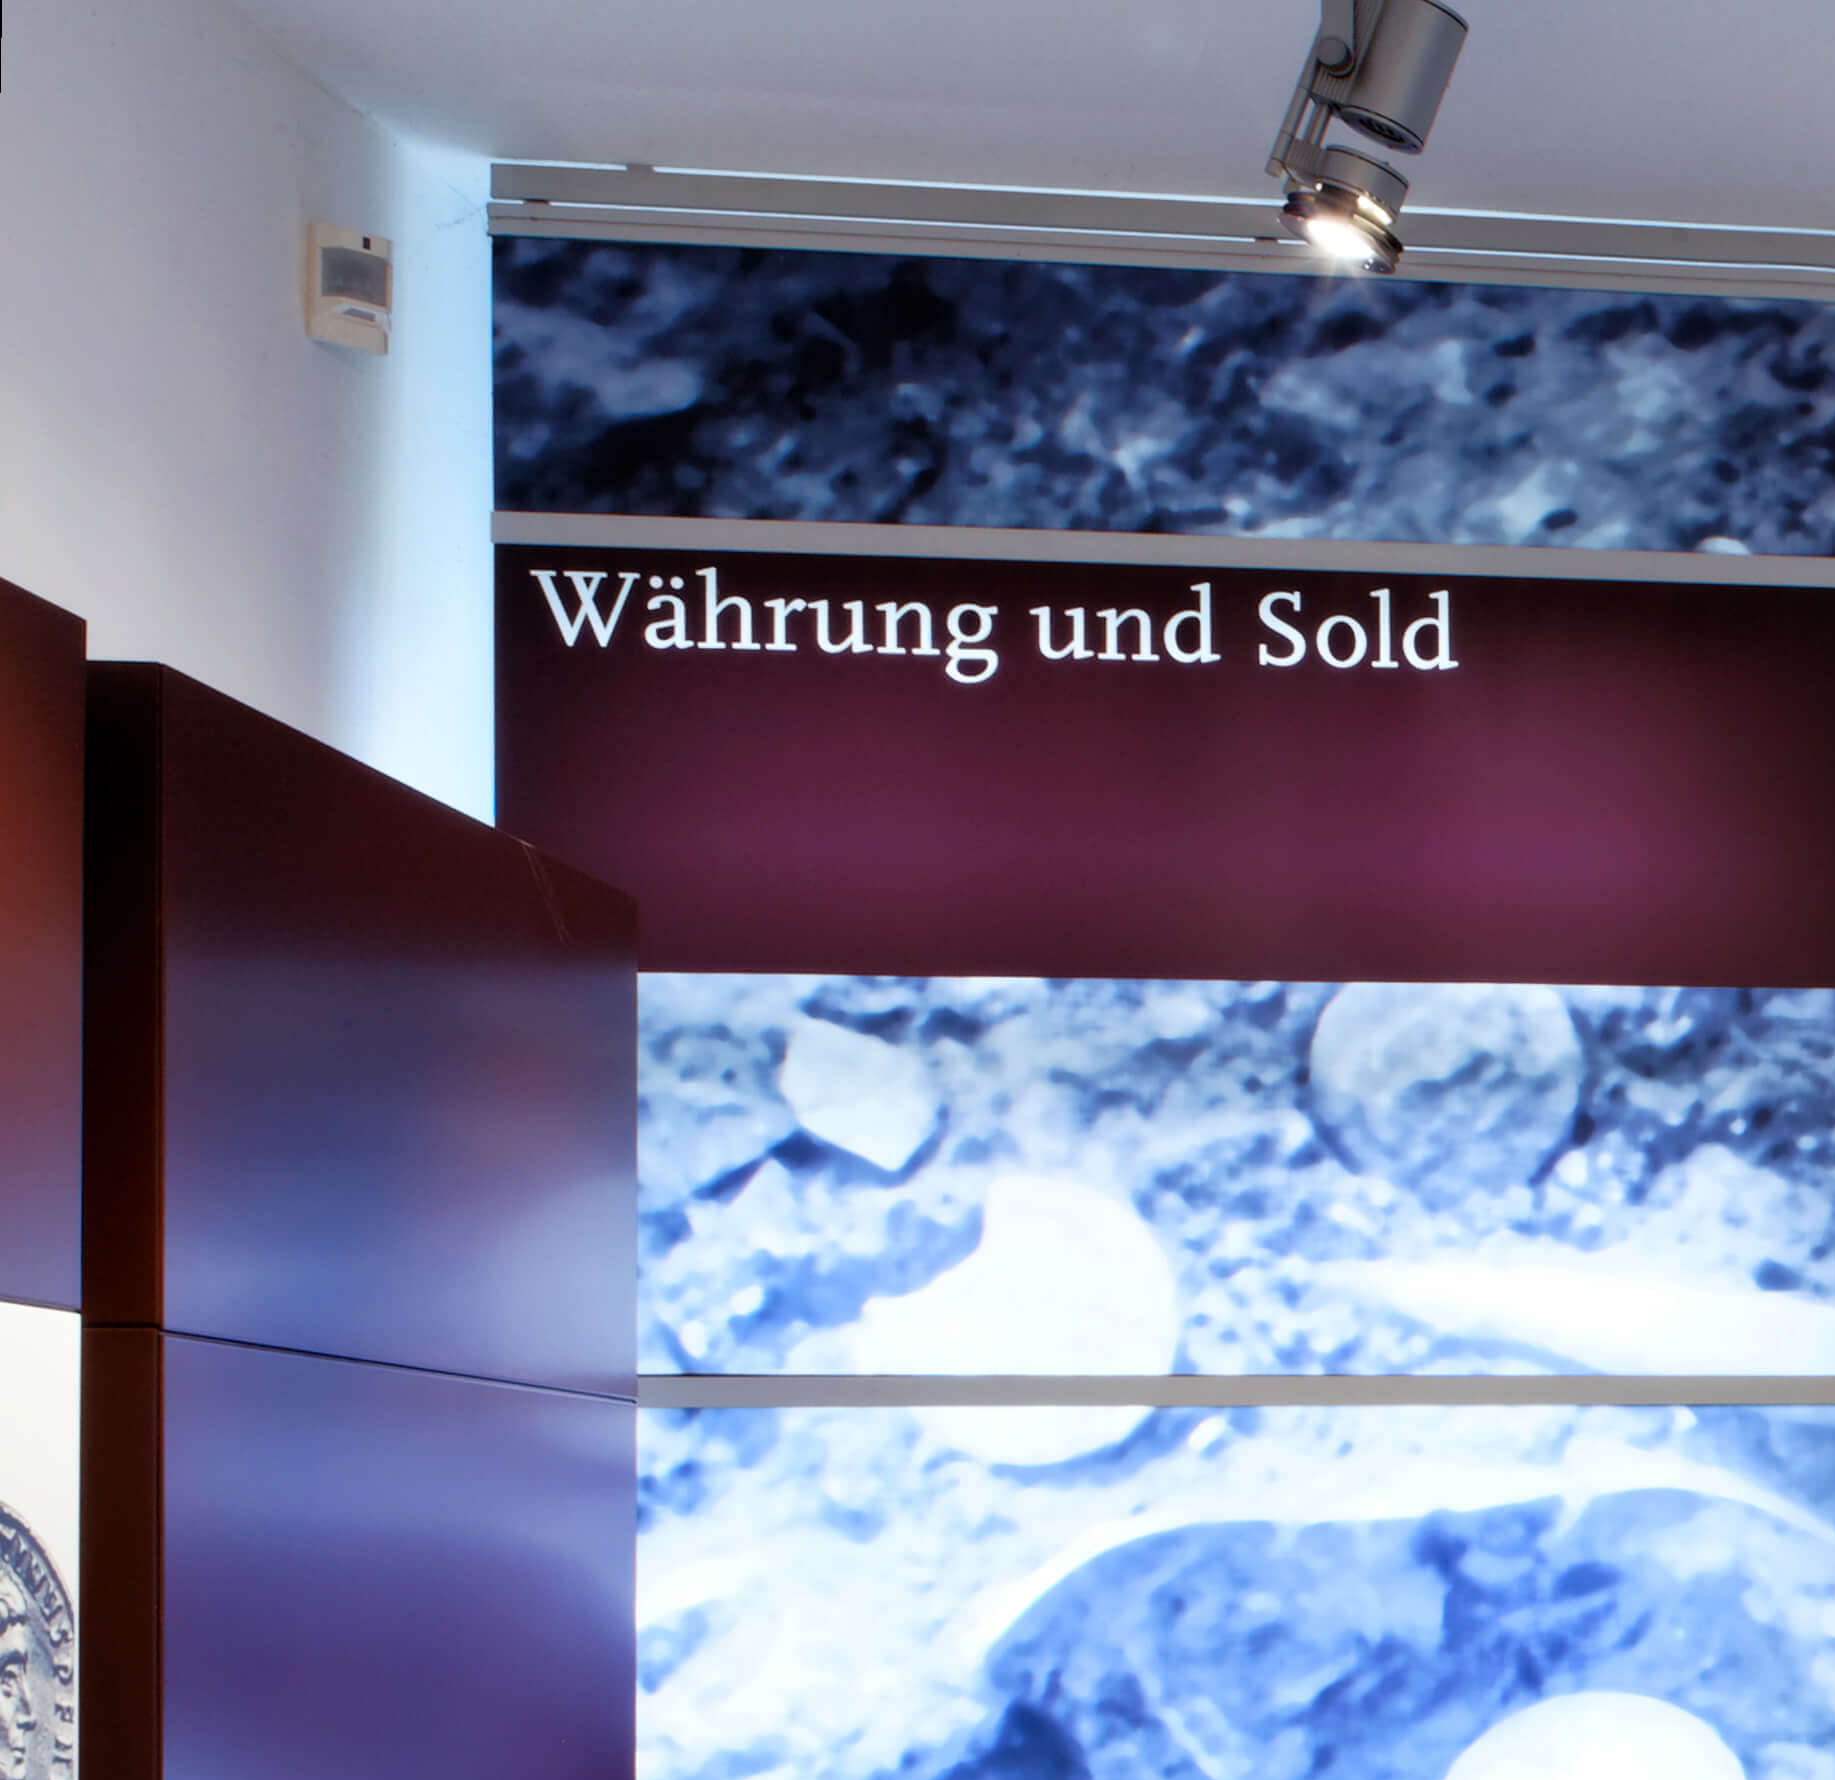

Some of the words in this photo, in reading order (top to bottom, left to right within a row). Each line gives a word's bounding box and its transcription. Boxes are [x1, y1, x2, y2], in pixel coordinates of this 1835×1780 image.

[529, 567, 999, 684] Währung
[1029, 582, 1221, 663] und
[1257, 588, 1459, 671] Sold
